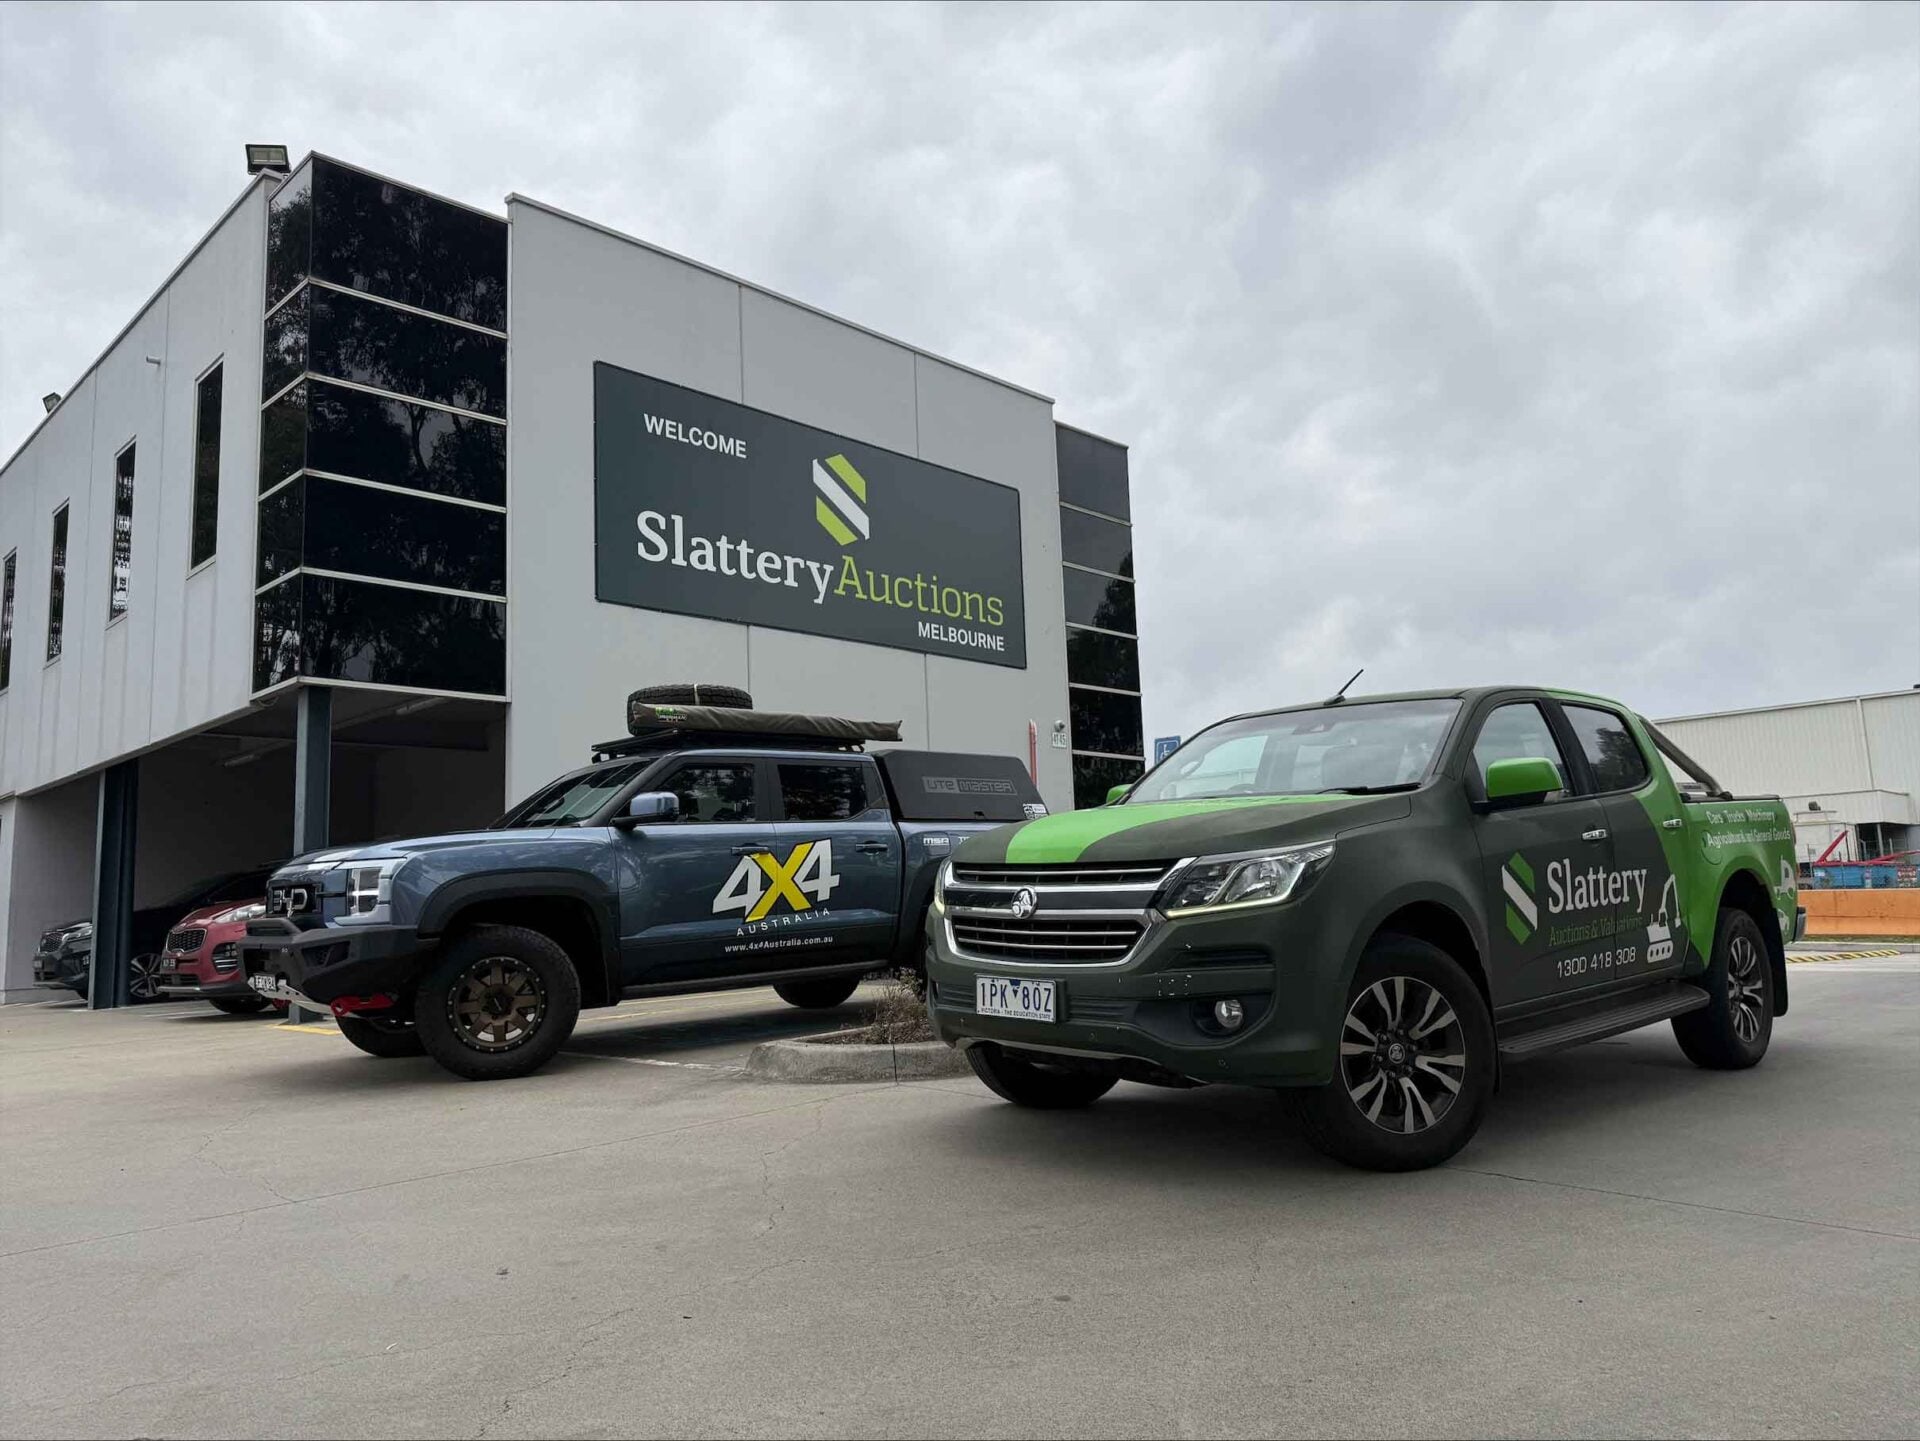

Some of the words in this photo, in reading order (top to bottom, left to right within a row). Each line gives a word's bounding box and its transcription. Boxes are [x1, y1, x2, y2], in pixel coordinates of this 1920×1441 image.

[643, 413, 747, 459] WELCOME
[918, 621, 1005, 651] MELBOURNE
[1547, 858, 1647, 914] Slattery
[736, 907, 830, 937] AUSTRALIA
[1557, 956, 1588, 979] 1300
[1590, 951, 1612, 971] 418
[1615, 946, 1636, 966] 308
[981, 983, 1008, 1009] 1PK
